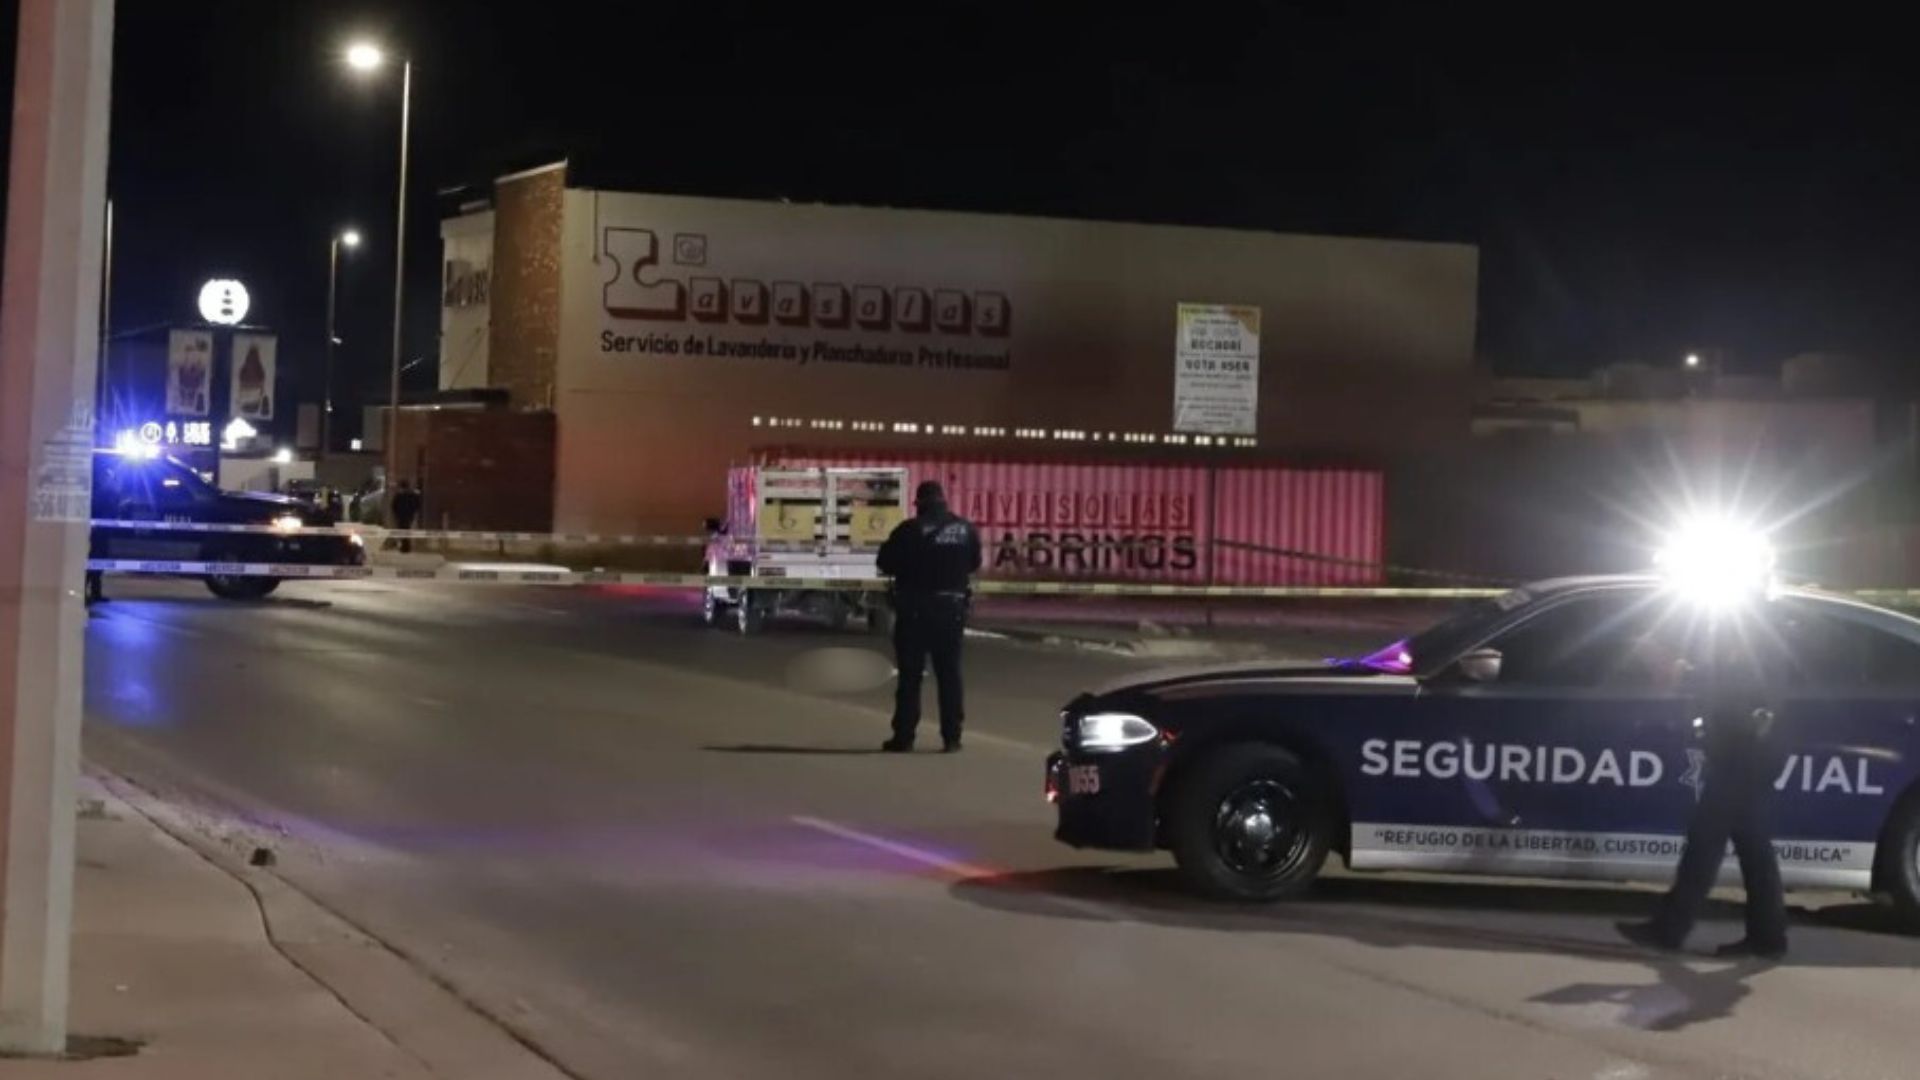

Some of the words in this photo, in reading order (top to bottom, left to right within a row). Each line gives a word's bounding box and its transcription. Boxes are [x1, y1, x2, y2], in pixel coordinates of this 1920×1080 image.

[601, 330, 679, 355] Servicio
[684, 334, 704, 355] de
[799, 344, 810, 364] y
[968, 492, 1193, 526] AVASOLAS
[996, 532, 1198, 570] ABRIMOS
[1360, 738, 1663, 788] SEGURIDAD
[1462, 832, 1485, 848] DE
[1488, 833, 1510, 850] LA
[1514, 835, 1600, 854] LIBERTAD,
